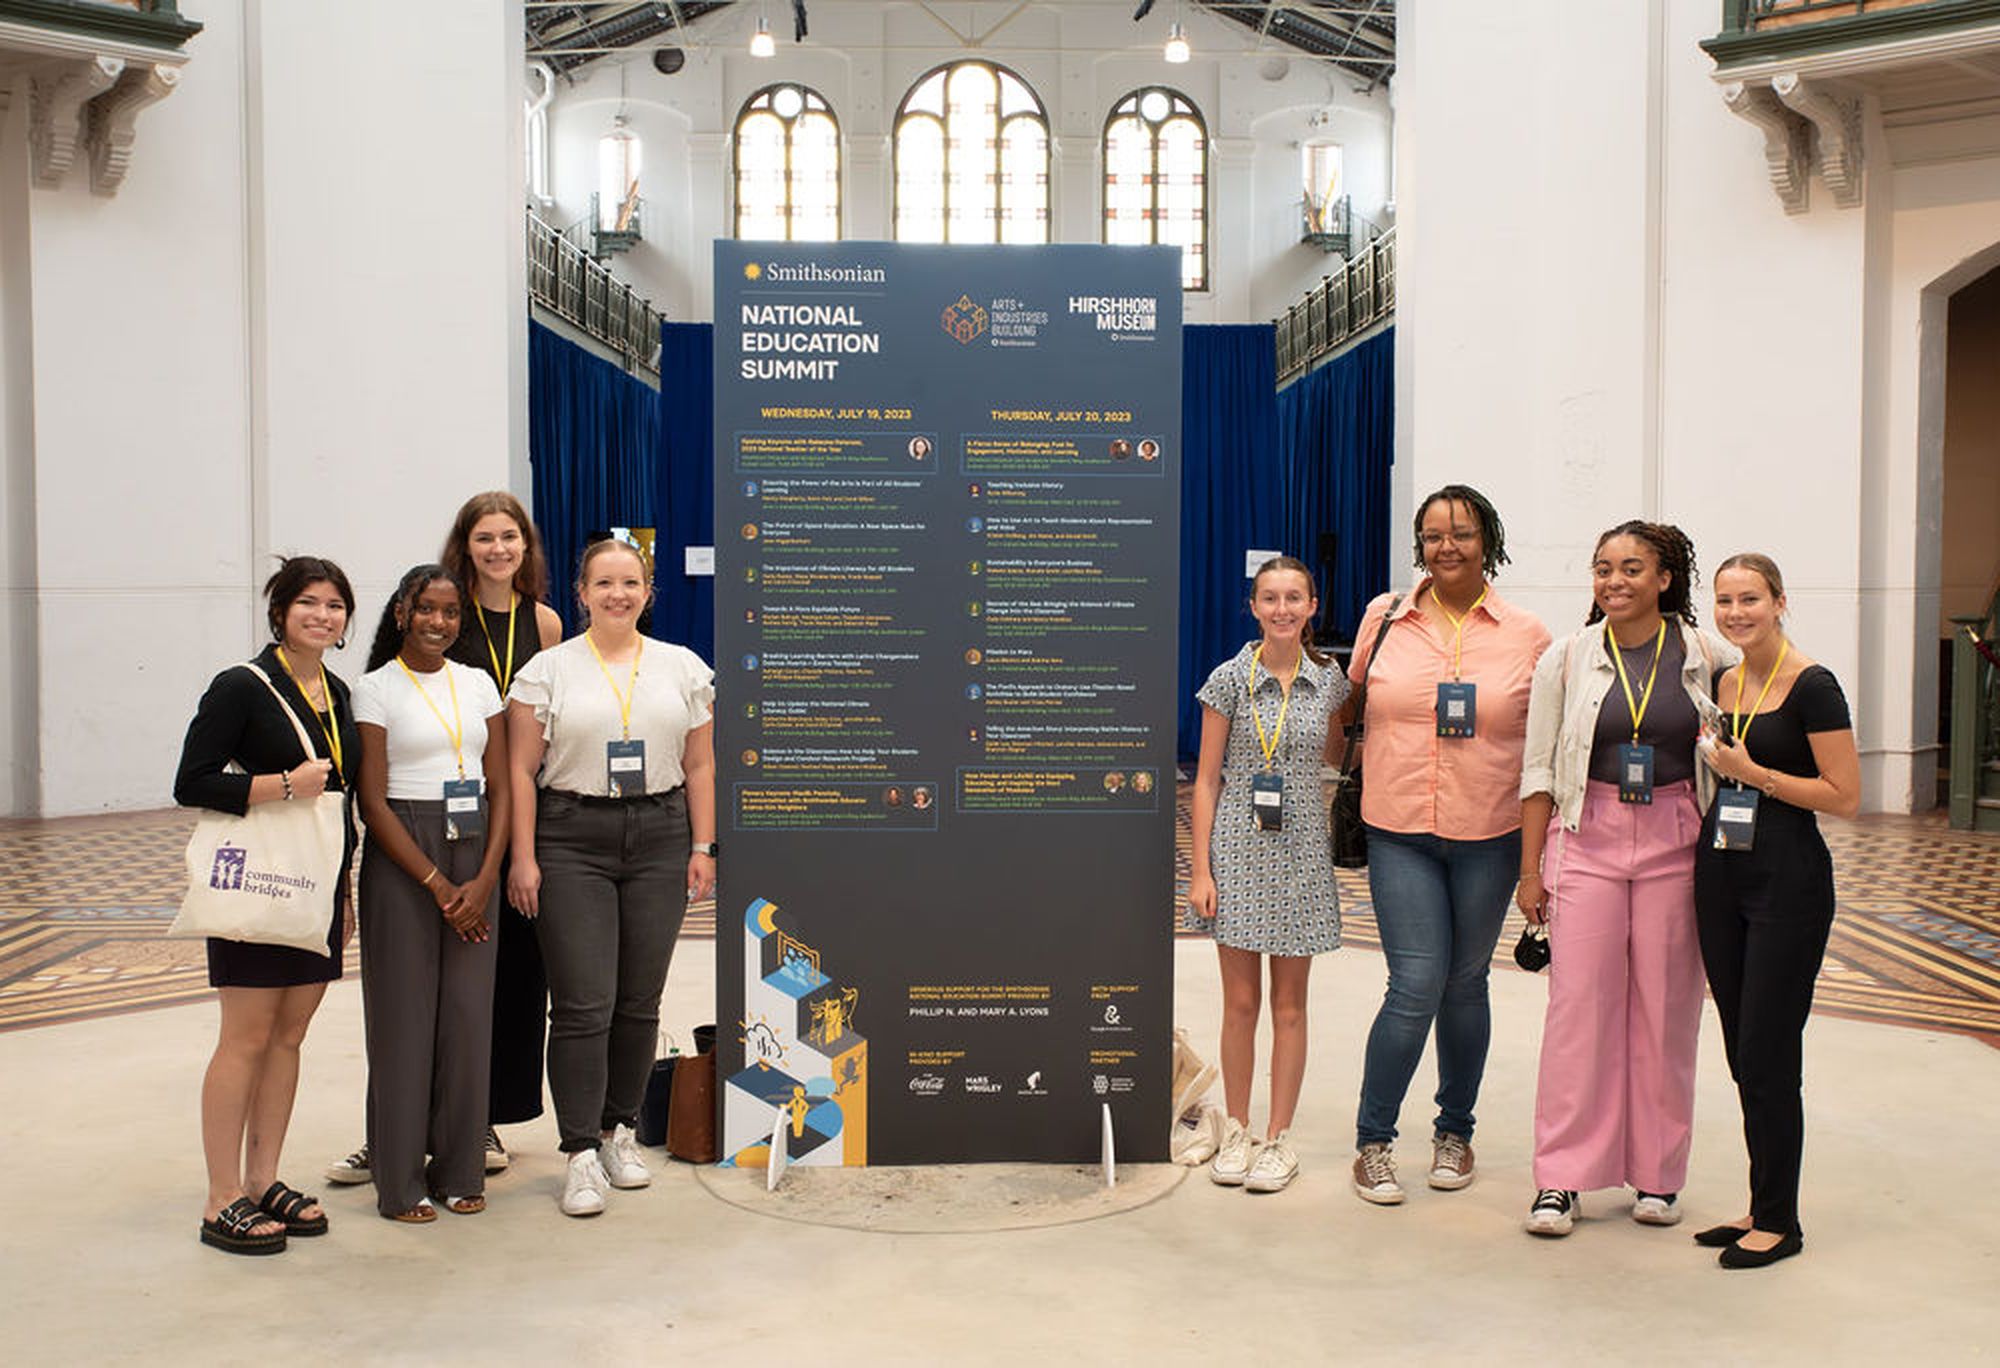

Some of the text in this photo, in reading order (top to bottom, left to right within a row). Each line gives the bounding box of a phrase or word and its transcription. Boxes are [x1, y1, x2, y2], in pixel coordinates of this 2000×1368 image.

[767, 262, 885, 282] Smithsonian
[992, 299, 1016, 310] ARTS
[1069, 297, 1157, 314] HIRSHHORN
[742, 305, 863, 326] NATIONAL
[991, 312, 1049, 325] INDUSTRIES
[1097, 314, 1156, 331] MUSEUM
[991, 325, 1037, 337] BUILDING
[742, 333, 879, 353] EDUCATION
[741, 360, 839, 380] SUMMIT
[761, 408, 912, 421] WEDNESDAY, JULY 19, 2023
[991, 411, 1132, 423] THURSDAY, JULY 20, 2023
[243, 879, 292, 900] bridges
[245, 870, 317, 893] community
[910, 1008, 1049, 1016] PHILLIP N. AND MARY A. LYONS
[965, 1084, 1002, 1093] WRIGLEY
